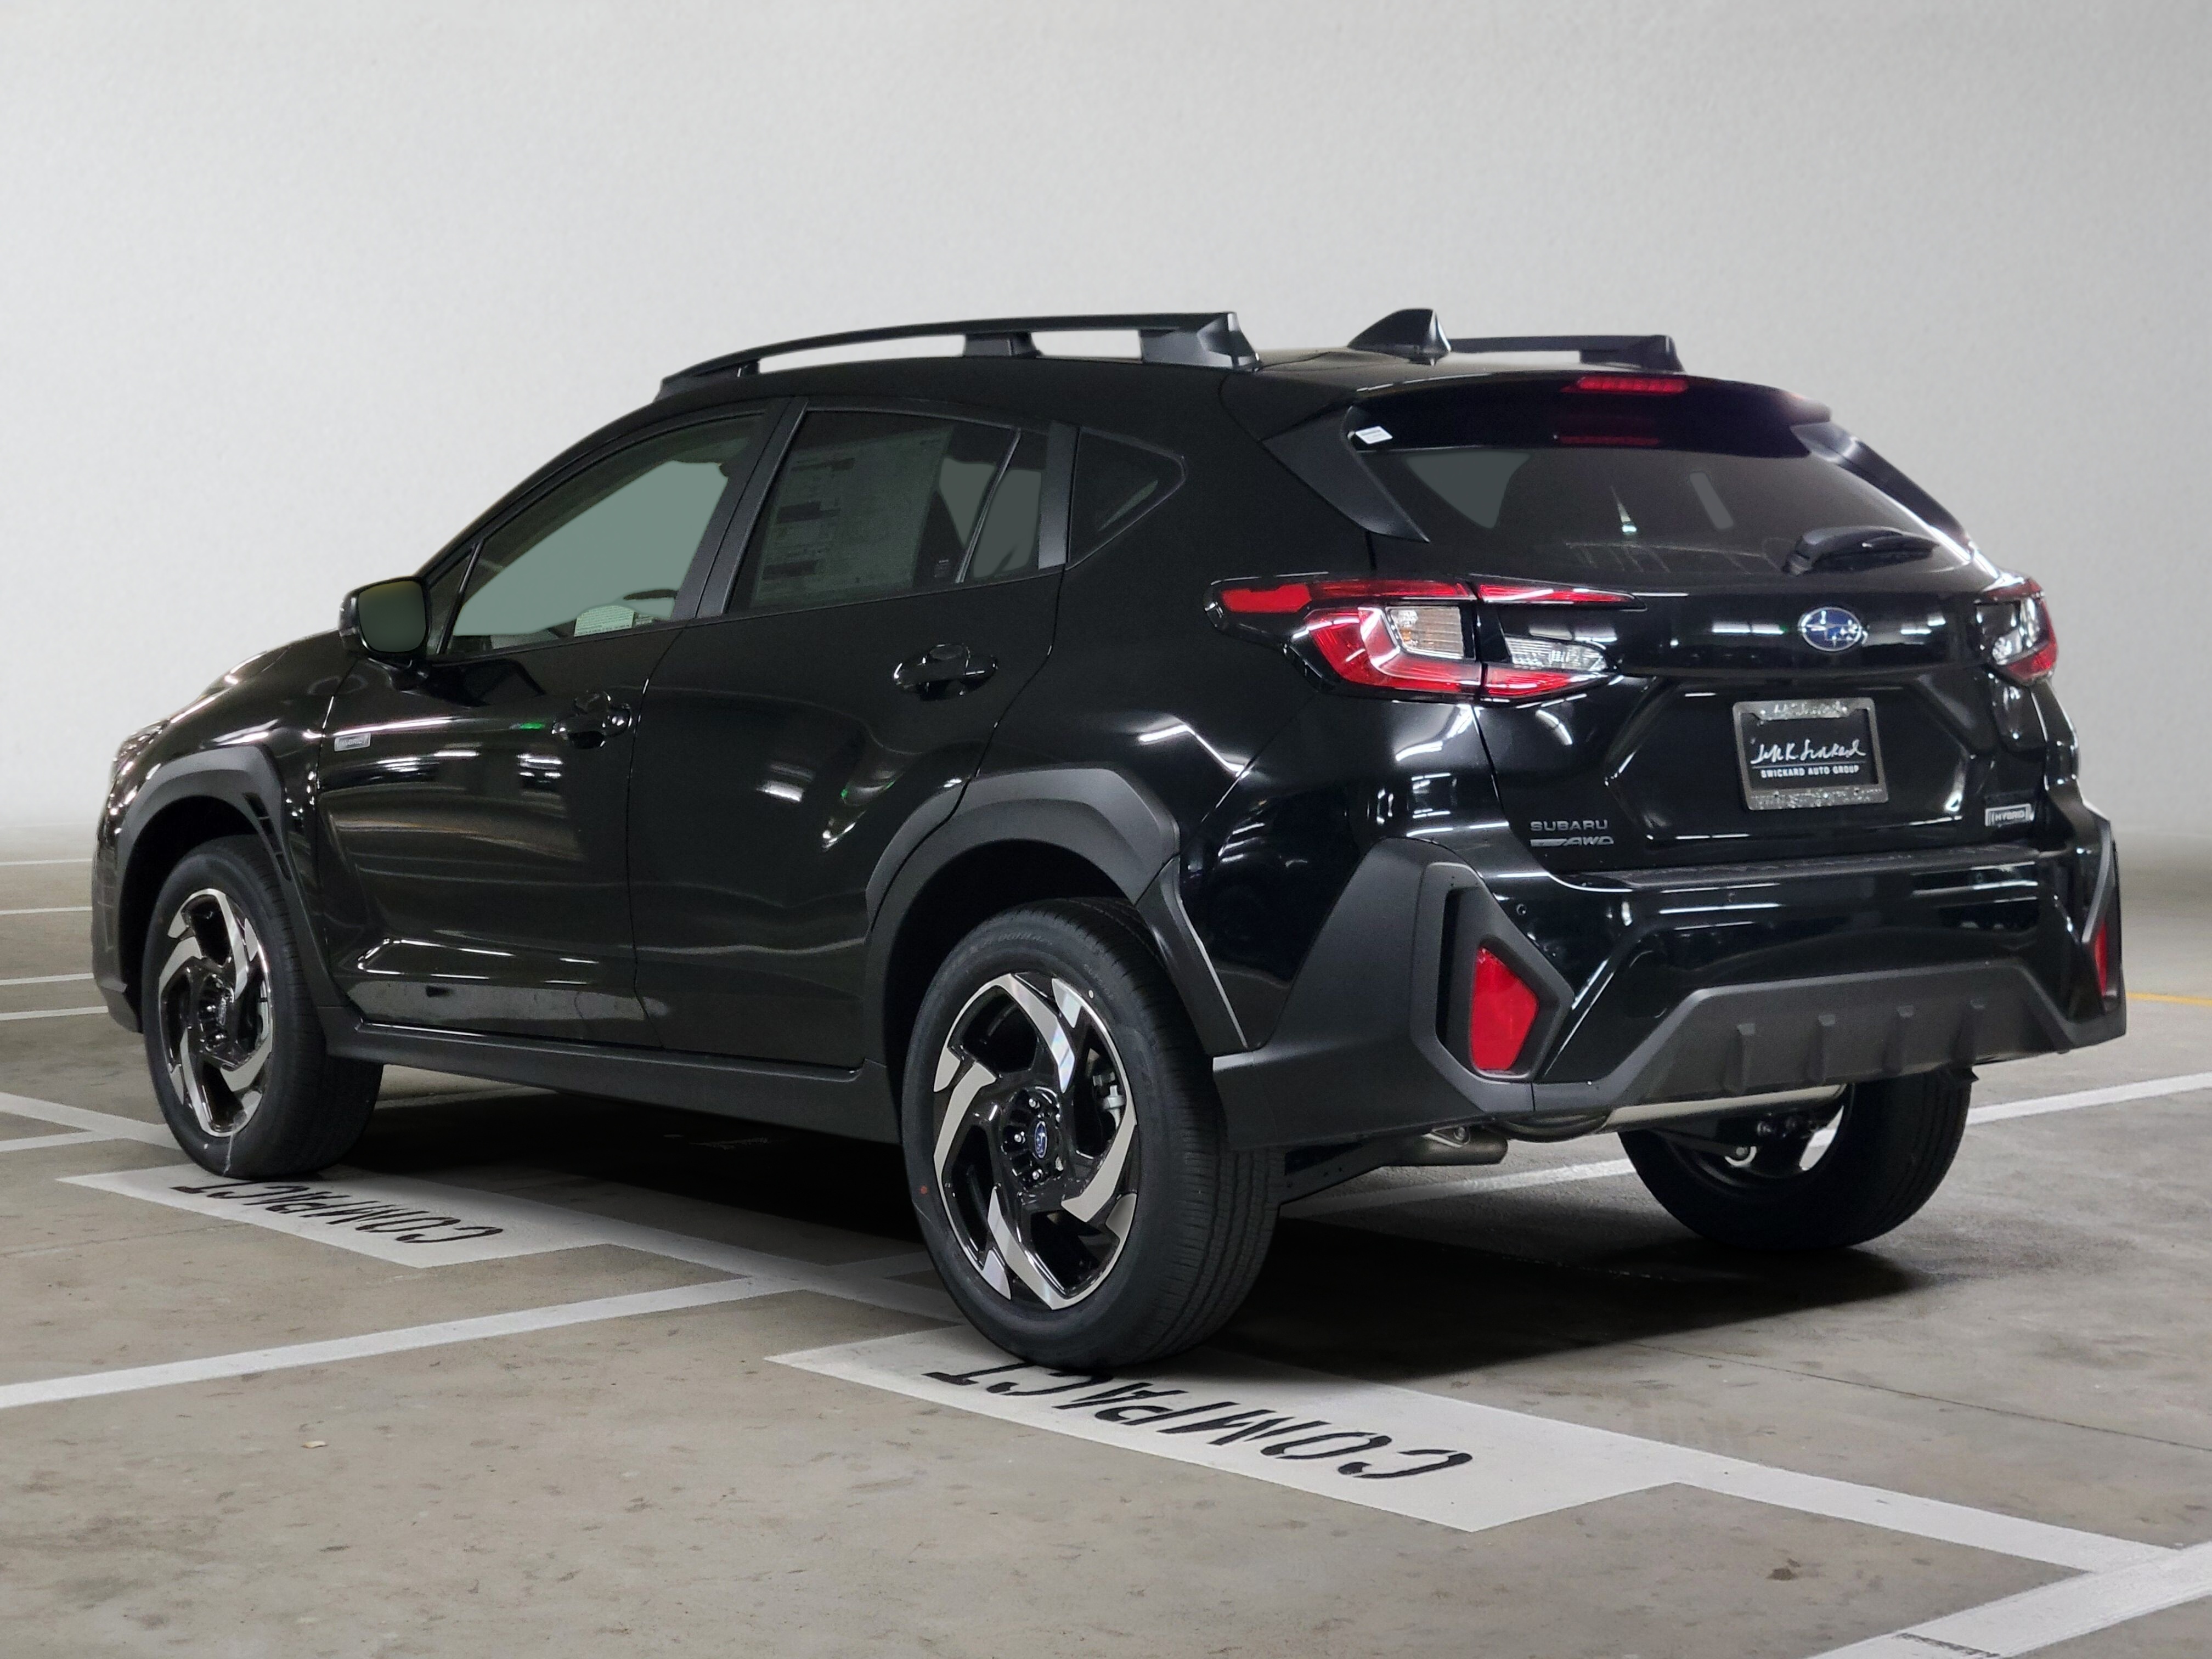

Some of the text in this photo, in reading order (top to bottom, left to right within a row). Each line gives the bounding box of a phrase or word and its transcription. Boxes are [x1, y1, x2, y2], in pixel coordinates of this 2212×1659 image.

[1760, 765, 1860, 778] SWICKARD AUTO GROUP
[1995, 810, 2025, 821] HYBRID
[1530, 820, 1608, 831] SUBARU
[1564, 836, 1614, 846] AWD
[169, 1181, 502, 1244] COMPACT
[922, 1363, 1474, 1480] COMPACT
